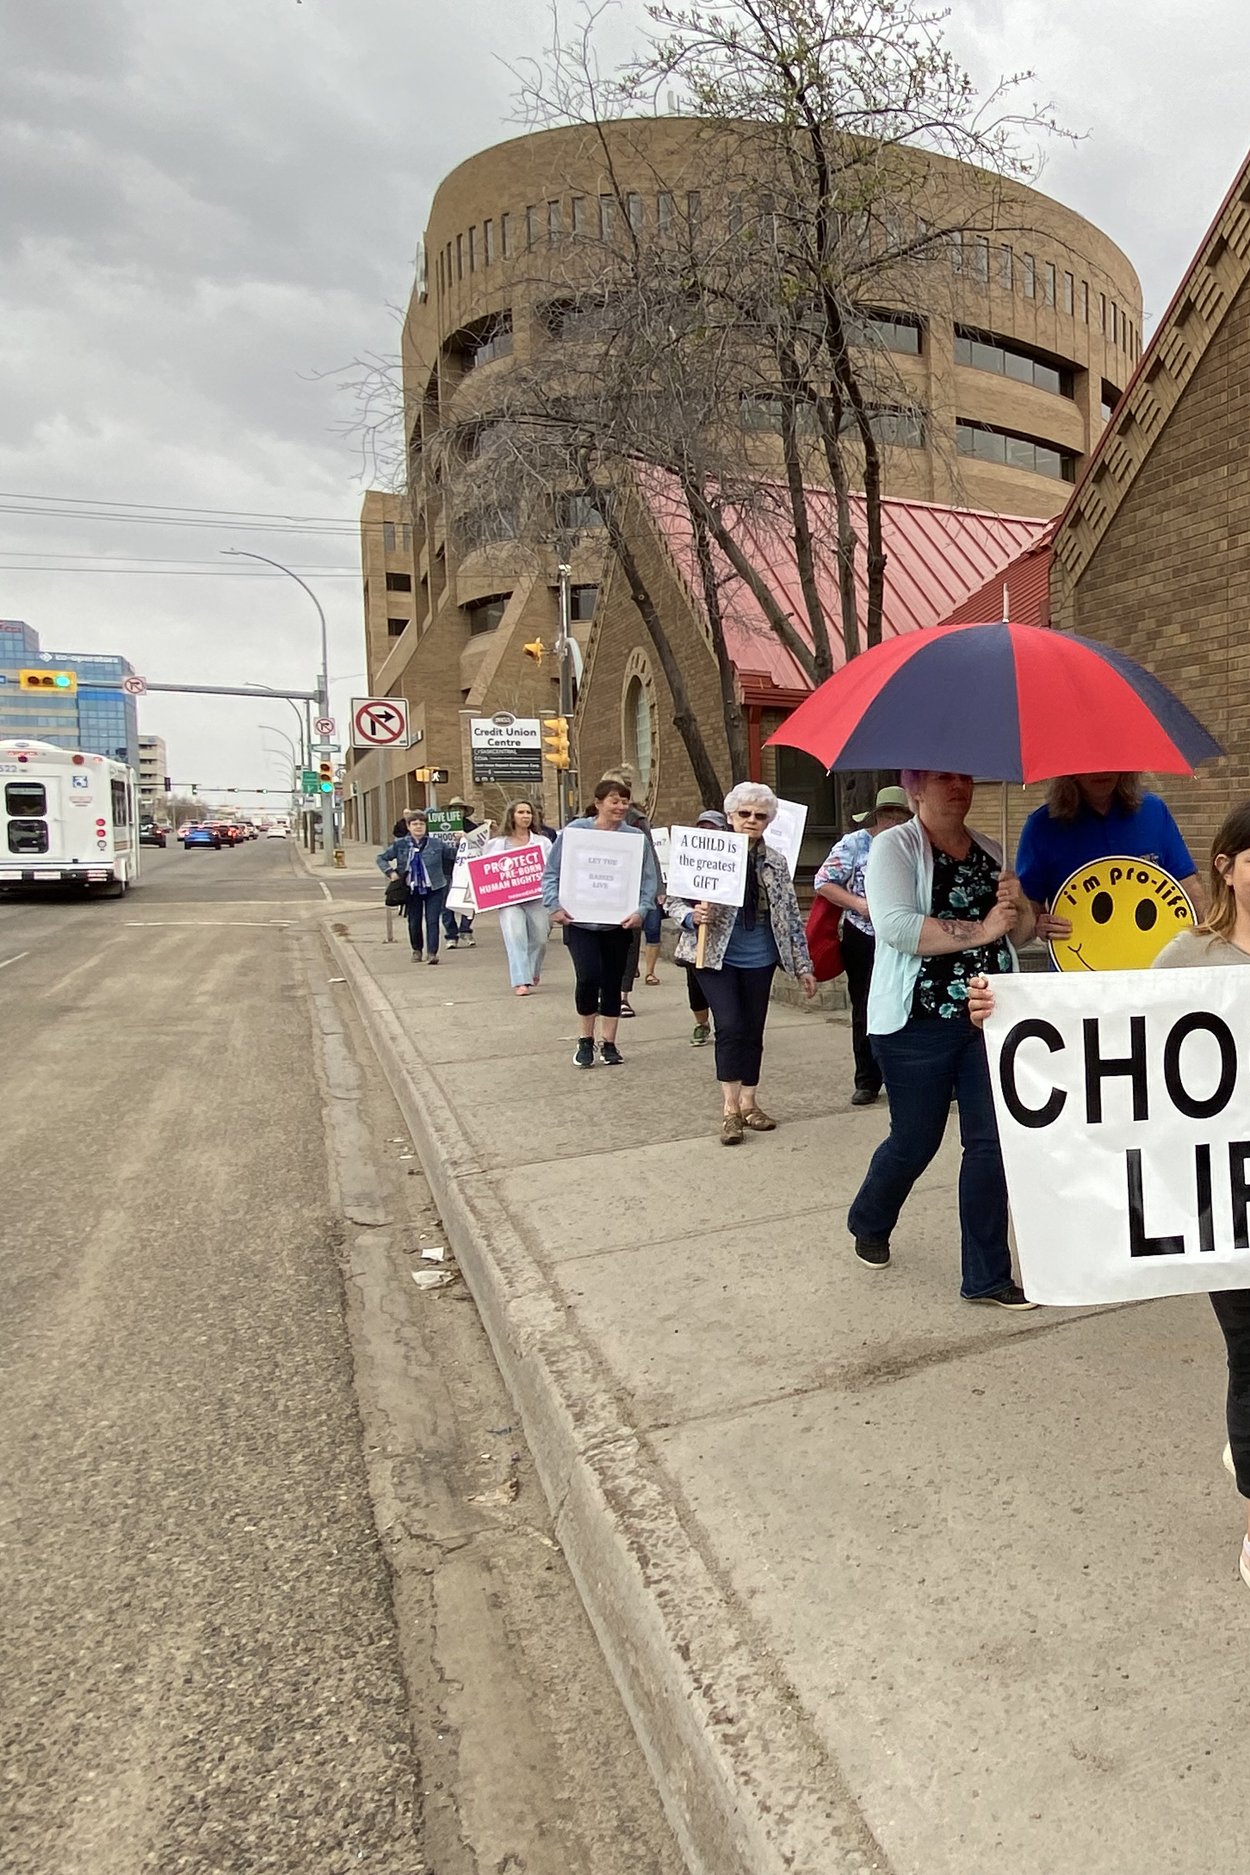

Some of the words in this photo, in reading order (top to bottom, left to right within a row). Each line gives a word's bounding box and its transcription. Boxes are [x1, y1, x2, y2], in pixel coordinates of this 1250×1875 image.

[474, 728, 503, 736] Credit
[506, 728, 536, 736] Union
[487, 738, 521, 746] Centre
[428, 812, 446, 823] LOVE
[446, 810, 461, 821] LIFE
[680, 835, 688, 847] A
[691, 835, 725, 852] CHILD
[728, 841, 737, 853] is
[679, 854, 695, 867] the
[696, 858, 736, 873] greatest
[500, 863, 542, 881] PRE-BORN
[479, 880, 511, 894] HUMAN
[693, 876, 719, 890] GIFT
[1063, 875, 1100, 905] i'm
[1110, 867, 1188, 919] pro-life
